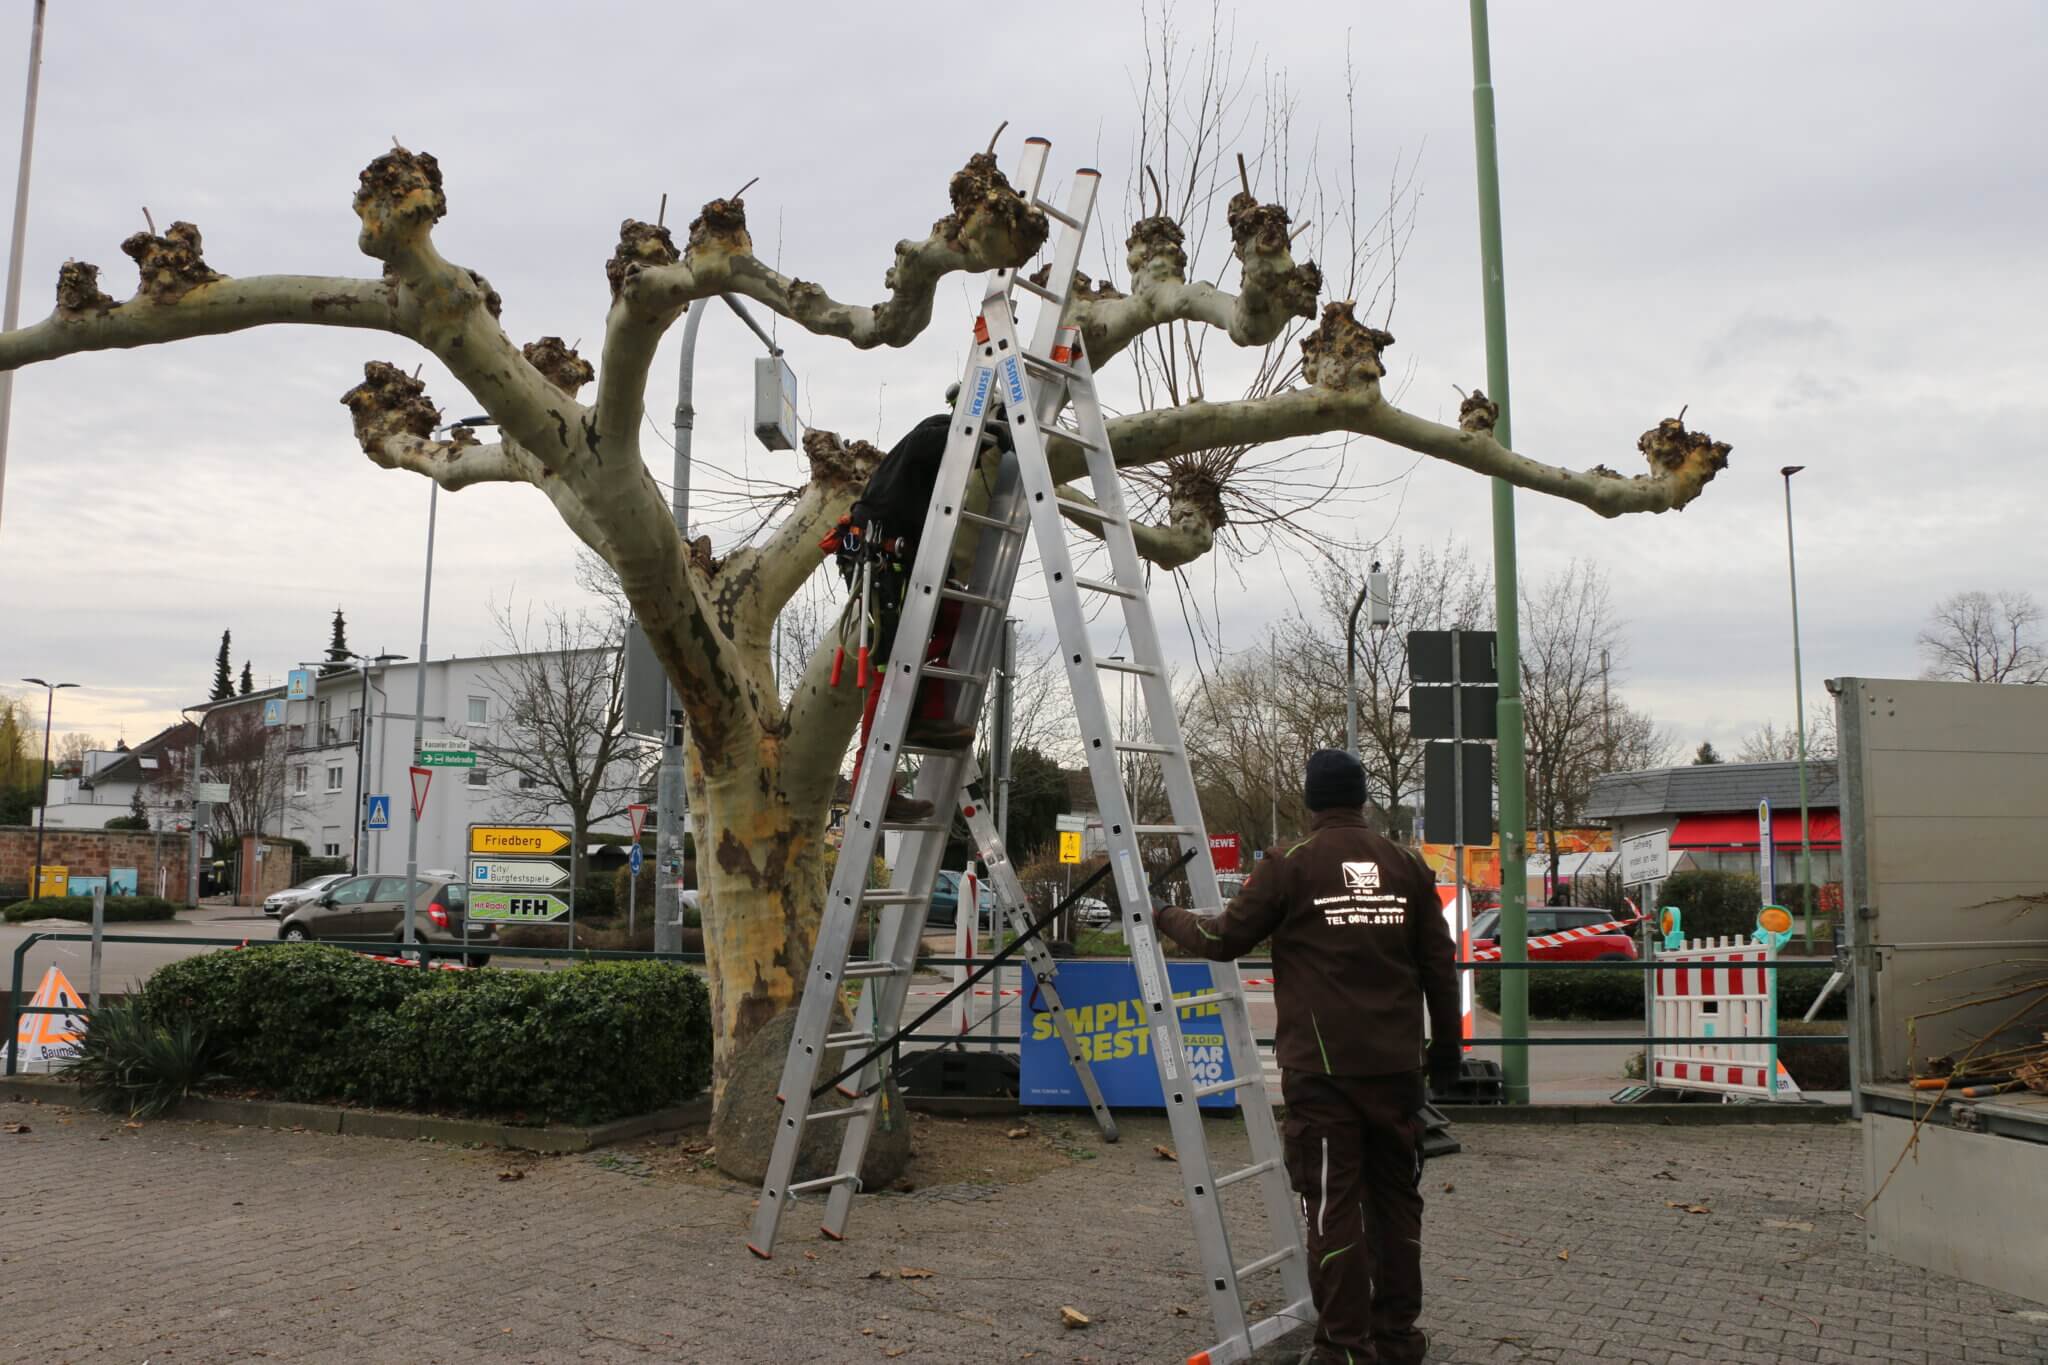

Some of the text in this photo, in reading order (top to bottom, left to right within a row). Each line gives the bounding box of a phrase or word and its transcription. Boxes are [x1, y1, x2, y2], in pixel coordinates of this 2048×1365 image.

[1006, 358, 1024, 402] KRAUSE
[972, 370, 991, 415] KRAUSE
[485, 835, 541, 848] Friedberg
[1209, 838, 1236, 849] REWE
[491, 873, 550, 884] Burgfestspiele
[510, 898, 548, 916] FFH
[1326, 916, 1346, 926] TEL
[1075, 1026, 1151, 1064] BEST
